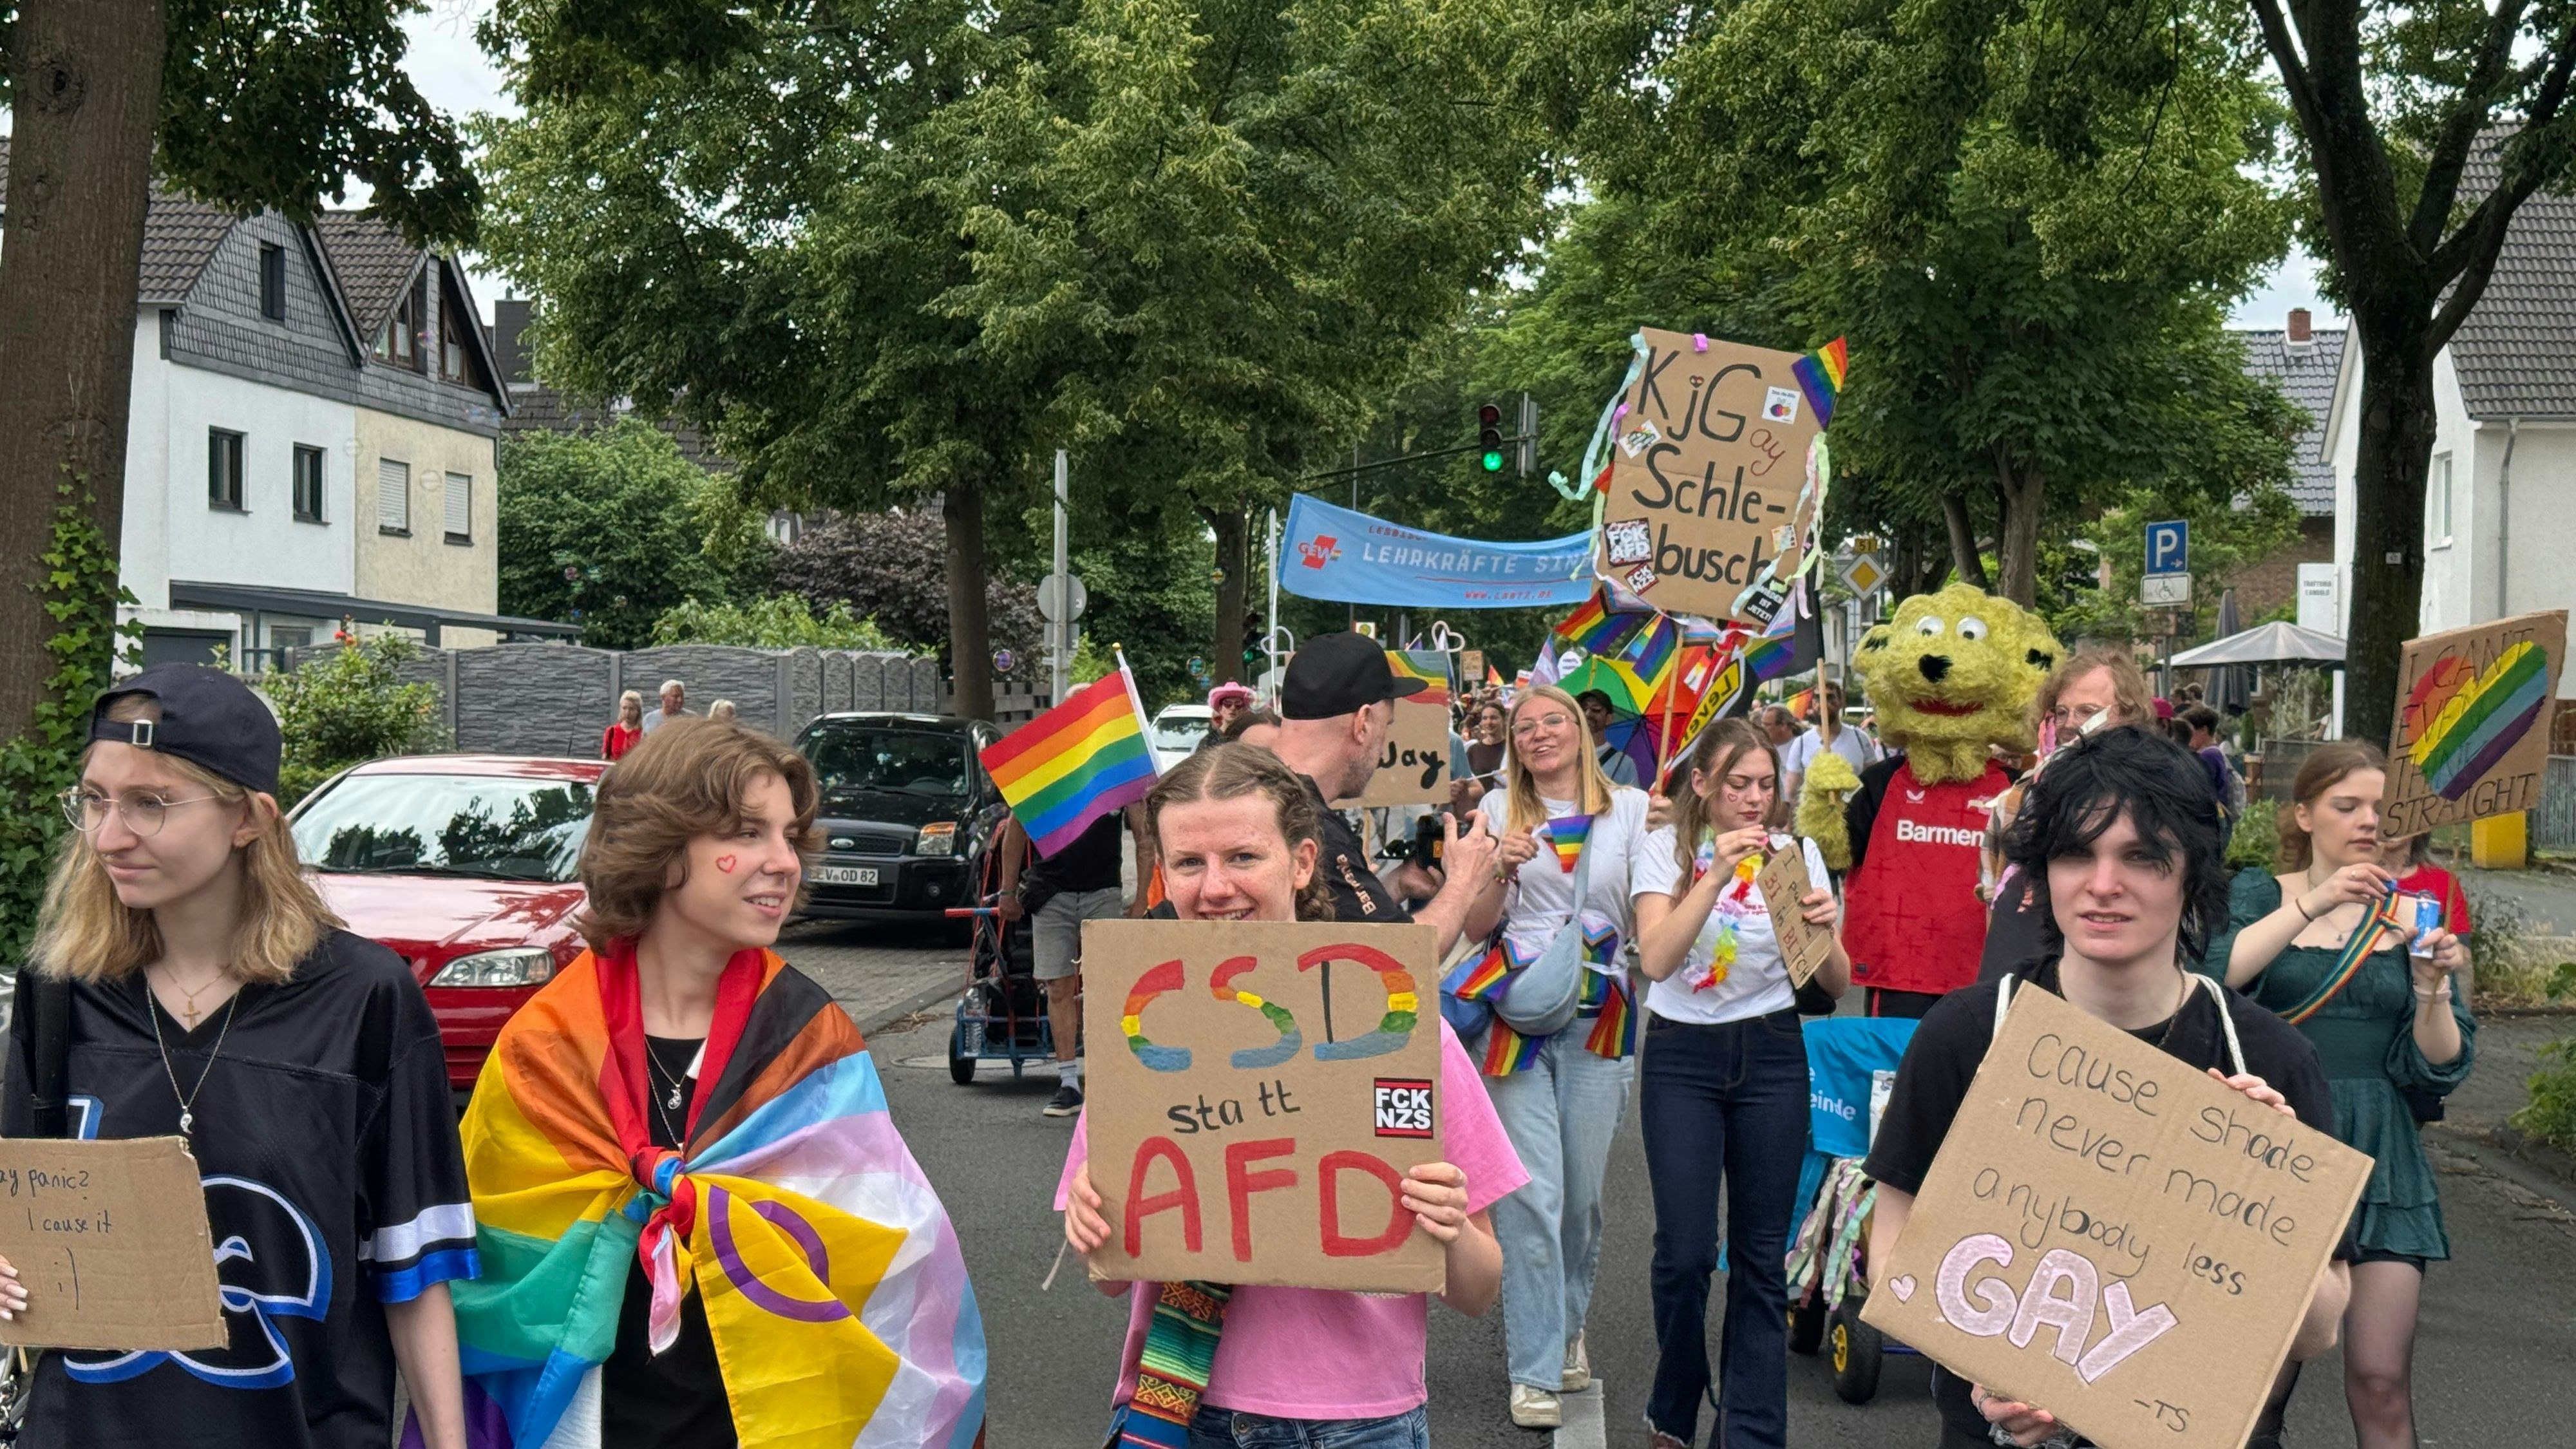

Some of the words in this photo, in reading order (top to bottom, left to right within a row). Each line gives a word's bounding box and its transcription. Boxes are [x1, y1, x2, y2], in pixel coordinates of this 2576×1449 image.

[1631, 443, 1786, 524] Schle-
[1362, 542, 1518, 574] LEHRKRÄFTE
[1654, 524, 1773, 586] busch
[2155, 529, 2178, 567] P
[2406, 652, 2418, 695] I
[841, 869, 858, 882] OD
[860, 871, 876, 883] 82
[1121, 943, 1417, 1073] CSD
[1376, 1088, 1432, 1109] FCK
[1376, 1108, 1432, 1129] NZS
[2016, 1095, 2150, 1174] never
[2164, 1168, 2295, 1247] made
[43, 1218, 88, 1233] cause
[97, 1209, 111, 1233] it
[1124, 1135, 1417, 1262] AFD
[1973, 1167, 2150, 1278] anybody
[2184, 1243, 2247, 1296] less
[1934, 1232, 2181, 1385] GAY
